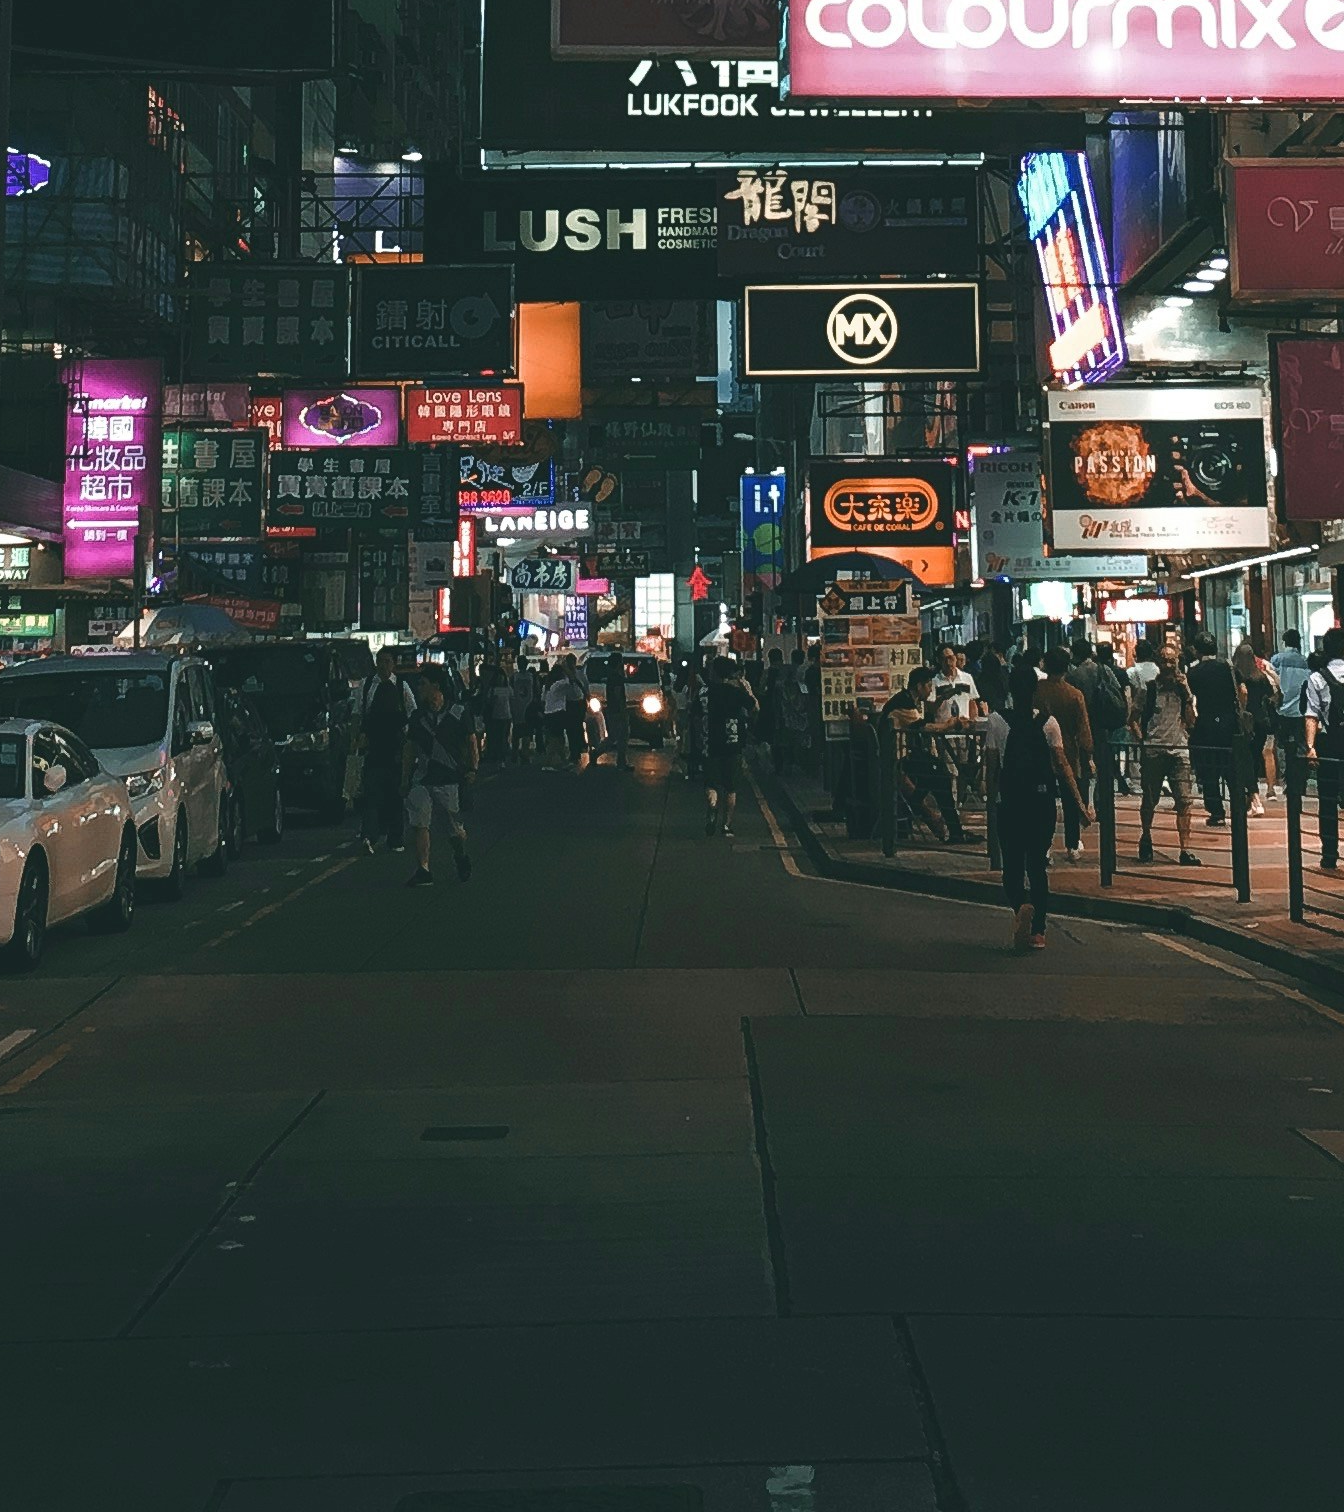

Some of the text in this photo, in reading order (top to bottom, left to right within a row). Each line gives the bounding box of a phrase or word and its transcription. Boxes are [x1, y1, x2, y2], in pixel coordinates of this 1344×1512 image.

[627, 92, 759, 117] LUKFOOK
[482, 207, 648, 252] LUSH
[776, 242, 827, 261] Court
[835, 311, 889, 346] MX
[370, 334, 461, 349] CITICALL
[425, 389, 503, 403] Love Lens
[1058, 400, 1096, 411] Canon
[980, 461, 1033, 474] RICOH
[1073, 454, 1156, 474] PASSION
[80, 472, 134, 501] 超市
[753, 484, 781, 513] i.t
[484, 508, 590, 532] LANEIGE
